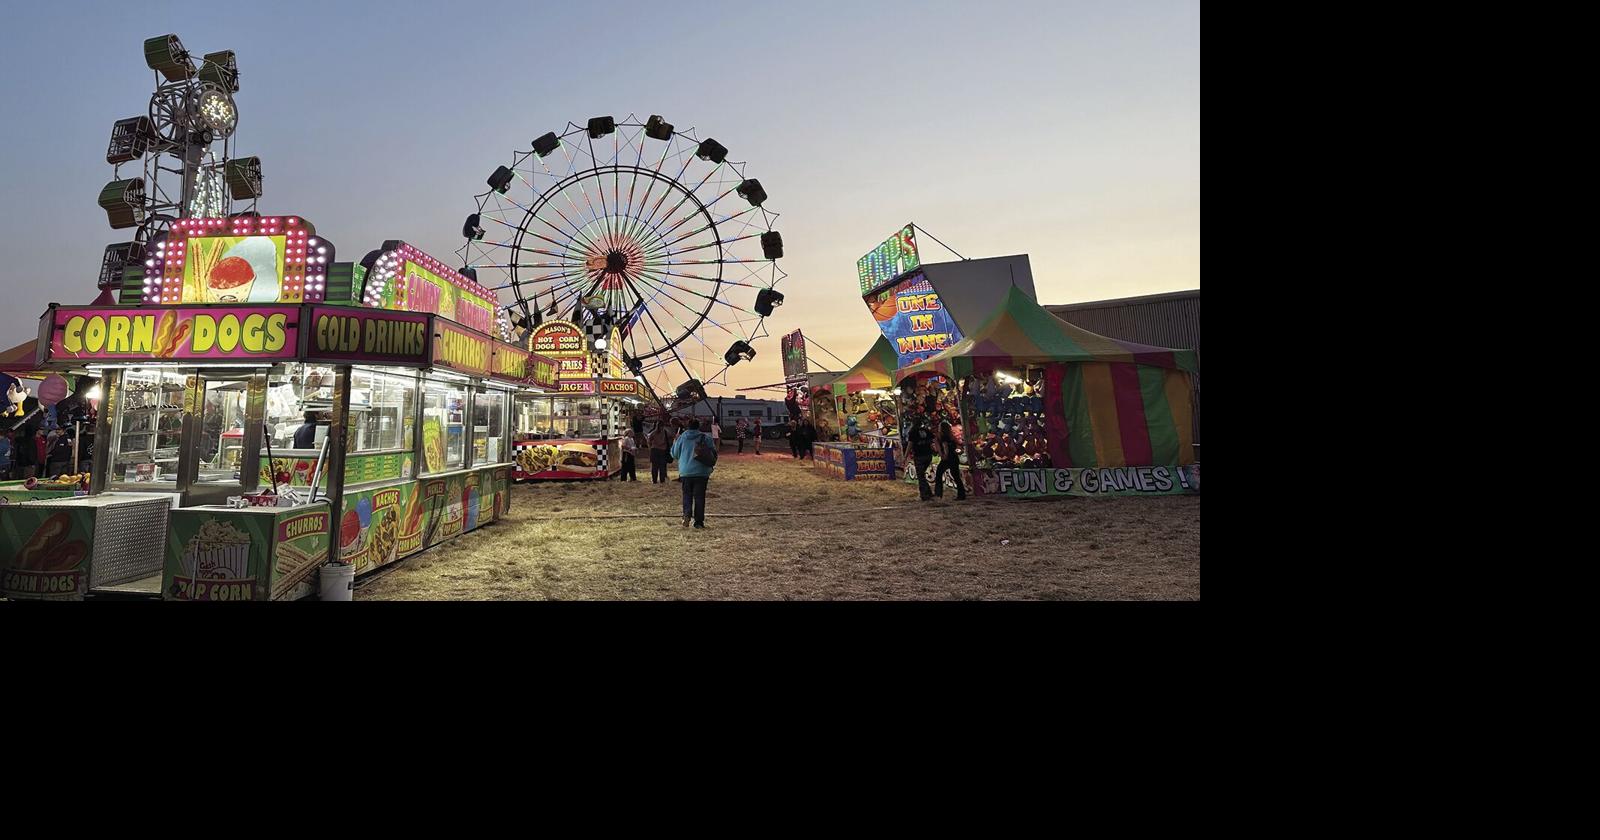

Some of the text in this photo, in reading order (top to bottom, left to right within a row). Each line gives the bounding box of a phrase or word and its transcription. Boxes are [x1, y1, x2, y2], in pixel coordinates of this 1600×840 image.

[858, 226, 916, 293] HOOPS
[896, 293, 942, 313] ONE
[544, 326, 572, 335] MASON'S
[909, 313, 934, 331] IN
[62, 312, 288, 354] CORN DOGS
[317, 314, 425, 355] COLD DRINKS
[442, 327, 488, 372] CHURROS
[561, 359, 583, 370] FRIES
[559, 382, 590, 391] URGER
[603, 382, 634, 392] NACHOS
[1000, 466, 1190, 494] FUN & GAMES !
[376, 491, 399, 508] NACHOS
[286, 516, 324, 538] CHURROS
[42, 575, 75, 592] DOGS
[210, 583, 252, 600] CORN
